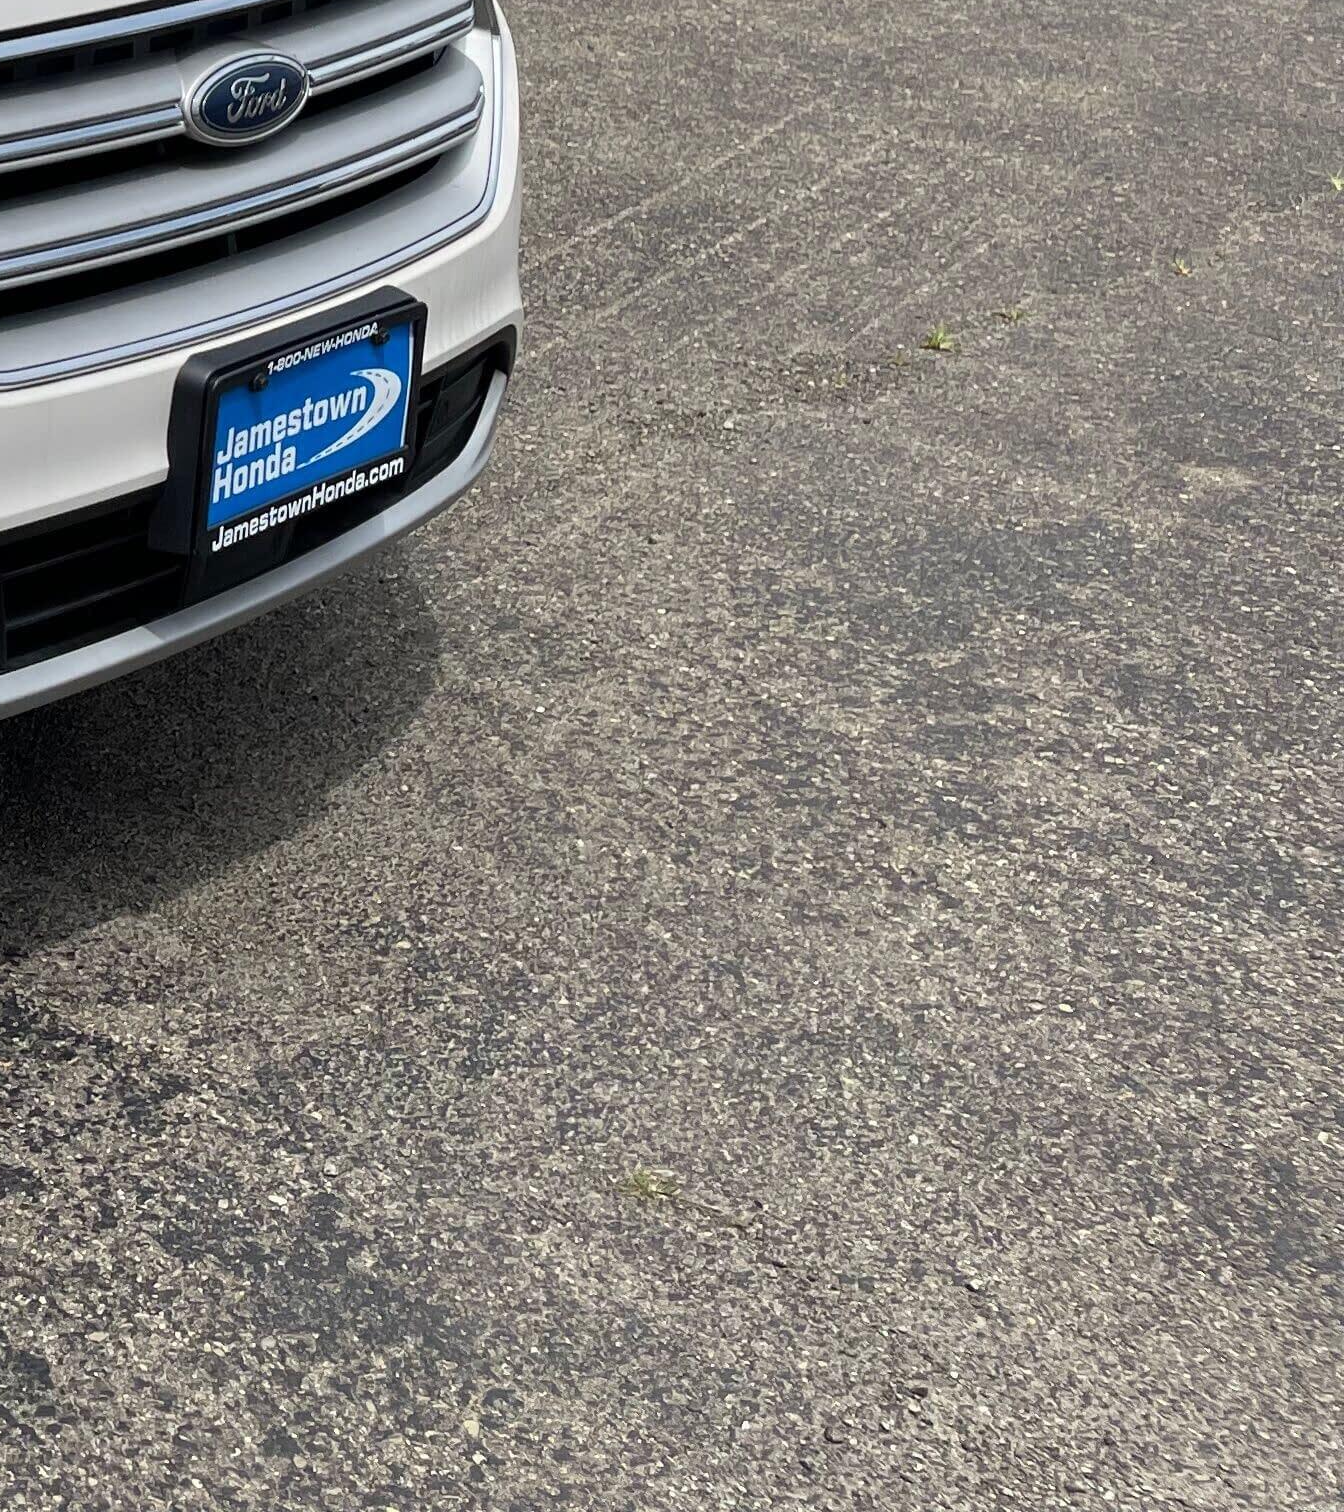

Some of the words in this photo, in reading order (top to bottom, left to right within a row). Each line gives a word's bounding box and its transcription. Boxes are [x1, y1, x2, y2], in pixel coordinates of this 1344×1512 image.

[226, 72, 287, 124] Ford
[267, 322, 378, 375] 1-800-NEW-HONDA
[217, 385, 367, 465] Jamestown
[212, 442, 296, 503] Honda
[212, 457, 404, 552] JamestownHonda.com
